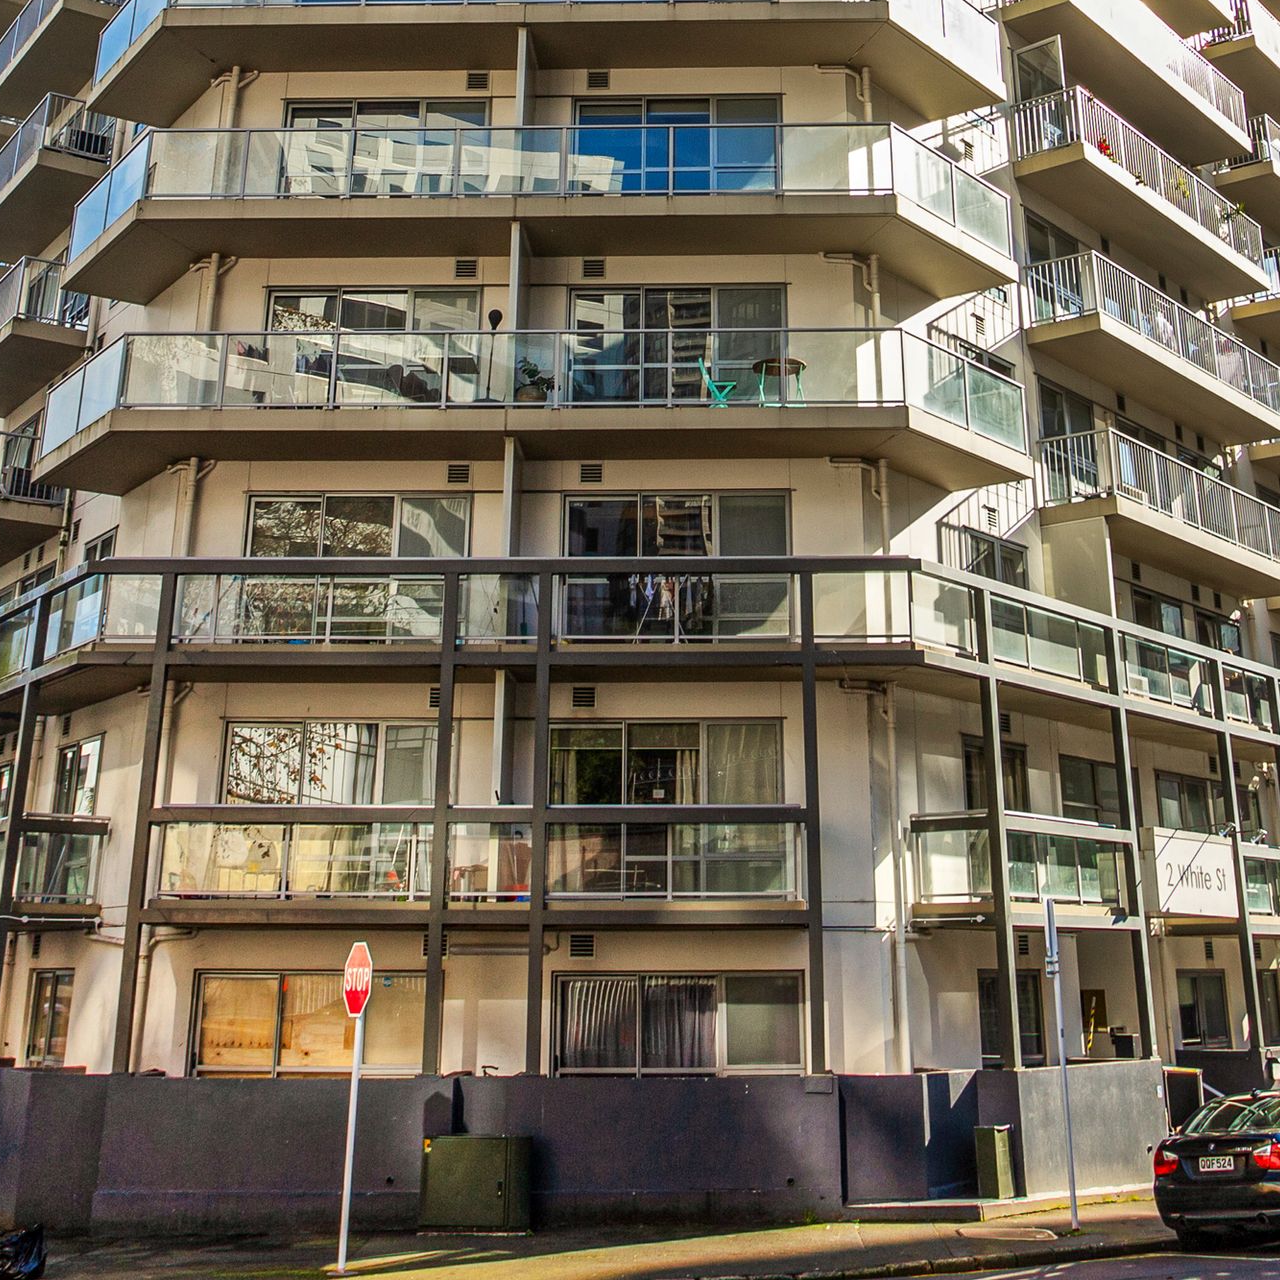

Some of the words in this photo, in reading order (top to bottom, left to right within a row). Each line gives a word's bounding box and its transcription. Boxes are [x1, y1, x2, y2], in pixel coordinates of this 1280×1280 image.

[1165, 862, 1174, 887] 2
[1178, 864, 1212, 891] White
[1215, 867, 1227, 892] St
[345, 967, 370, 992] STOP
